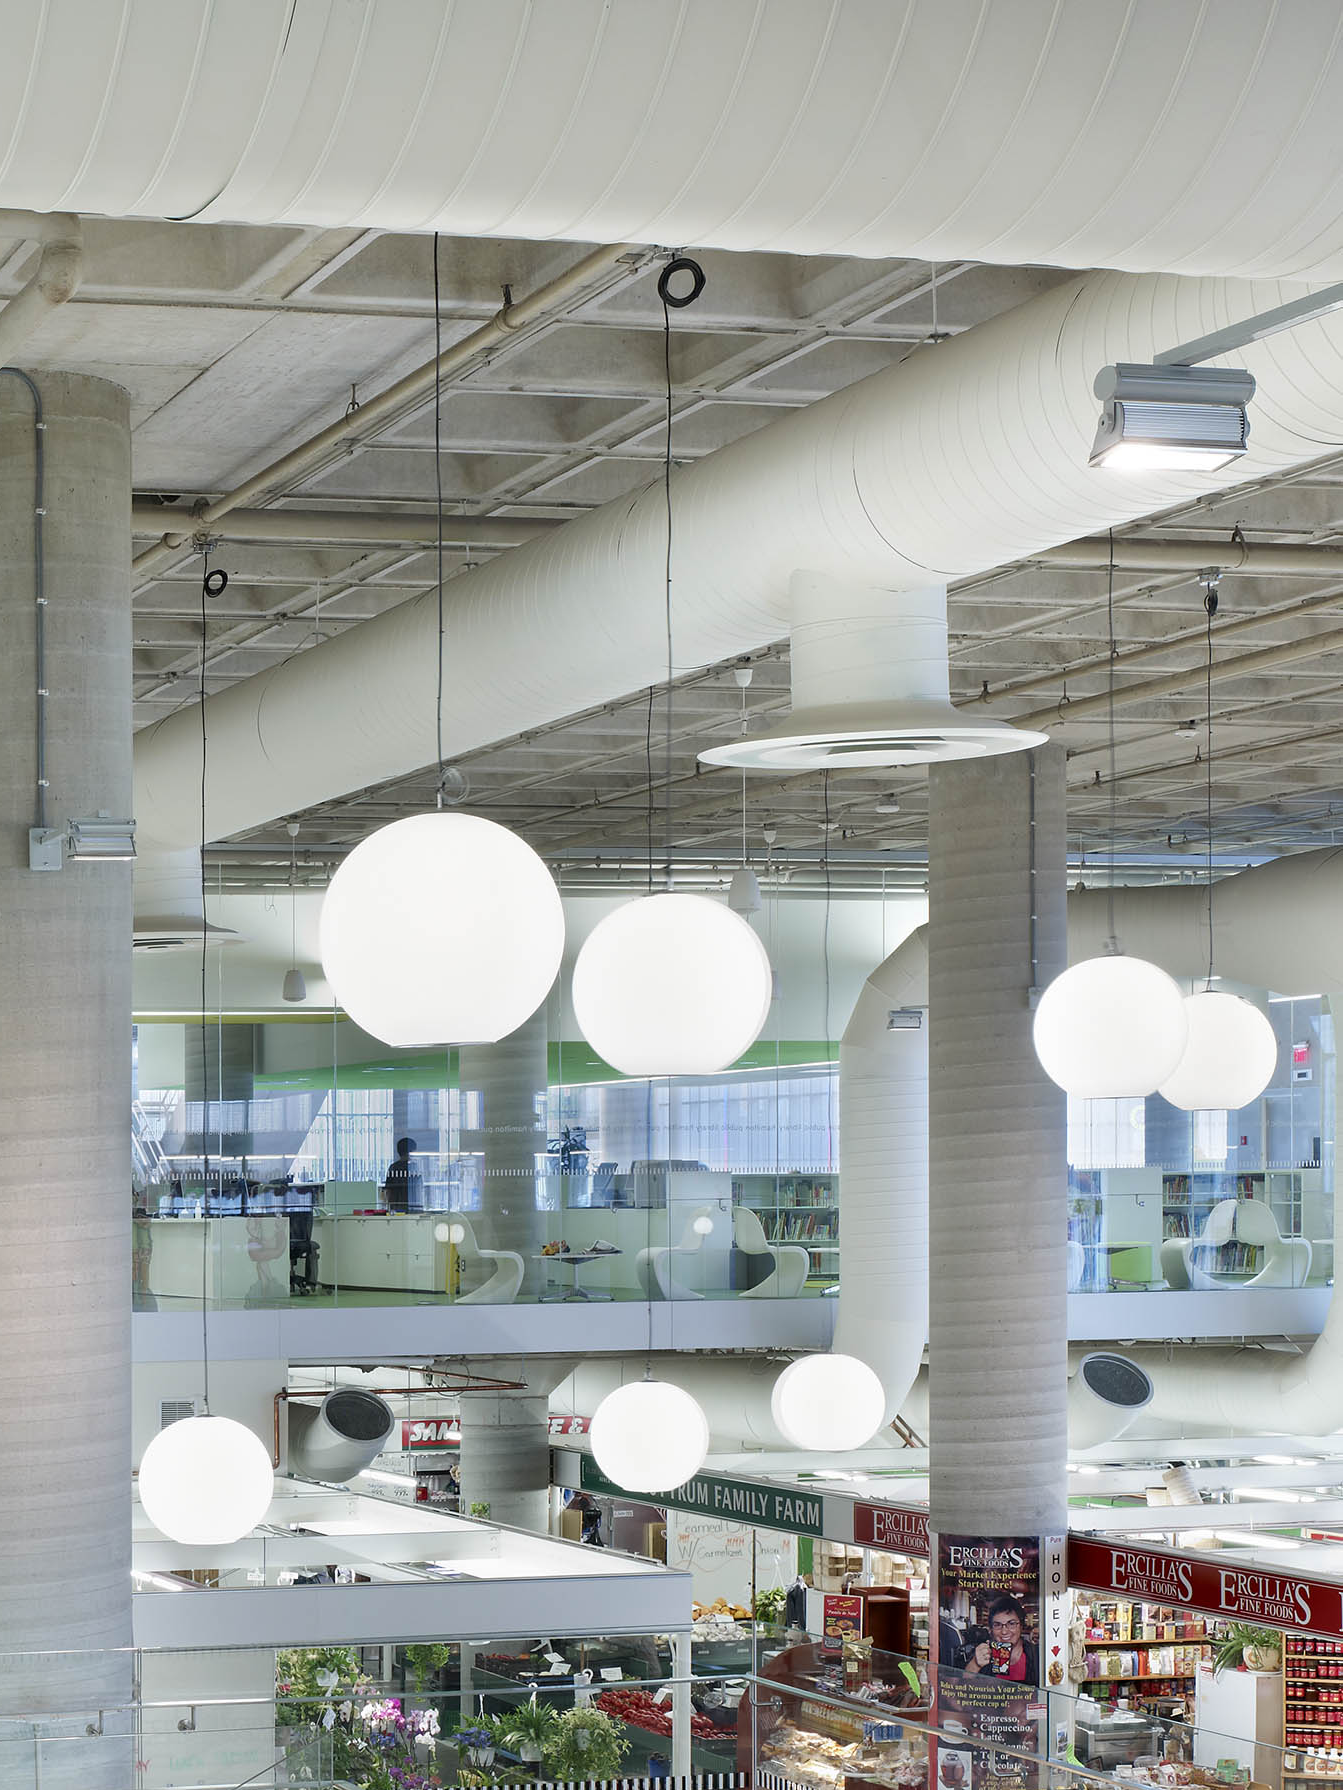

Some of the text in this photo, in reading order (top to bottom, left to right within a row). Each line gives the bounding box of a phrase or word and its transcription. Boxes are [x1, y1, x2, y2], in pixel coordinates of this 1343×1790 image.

[714, 1485, 769, 1517] FAMILY
[775, 1495, 820, 1527] FARM
[886, 1532, 925, 1549] FINE FOODS
[949, 1545, 1024, 1569] ERCILIA'S
[941, 1567, 1037, 1581] Your Market Experience
[958, 1578, 1013, 1589] Starts Here!
[1109, 1550, 1193, 1602] ERCILIA'S
[1051, 1553, 1061, 1638] HONEY
[1129, 1576, 1177, 1598] FINE FOODS
[1218, 1569, 1312, 1625] ERCILIA'S
[1240, 1597, 1294, 1620] FINE FOODS
[957, 1690, 968, 1698] the
[993, 1692, 1006, 1700] and
[1024, 1692, 1033, 1700] of
[968, 1685, 996, 1693] Nourish
[980, 1714, 1020, 1723] Espresso,
[980, 1723, 1033, 1733] Cappuccino,
